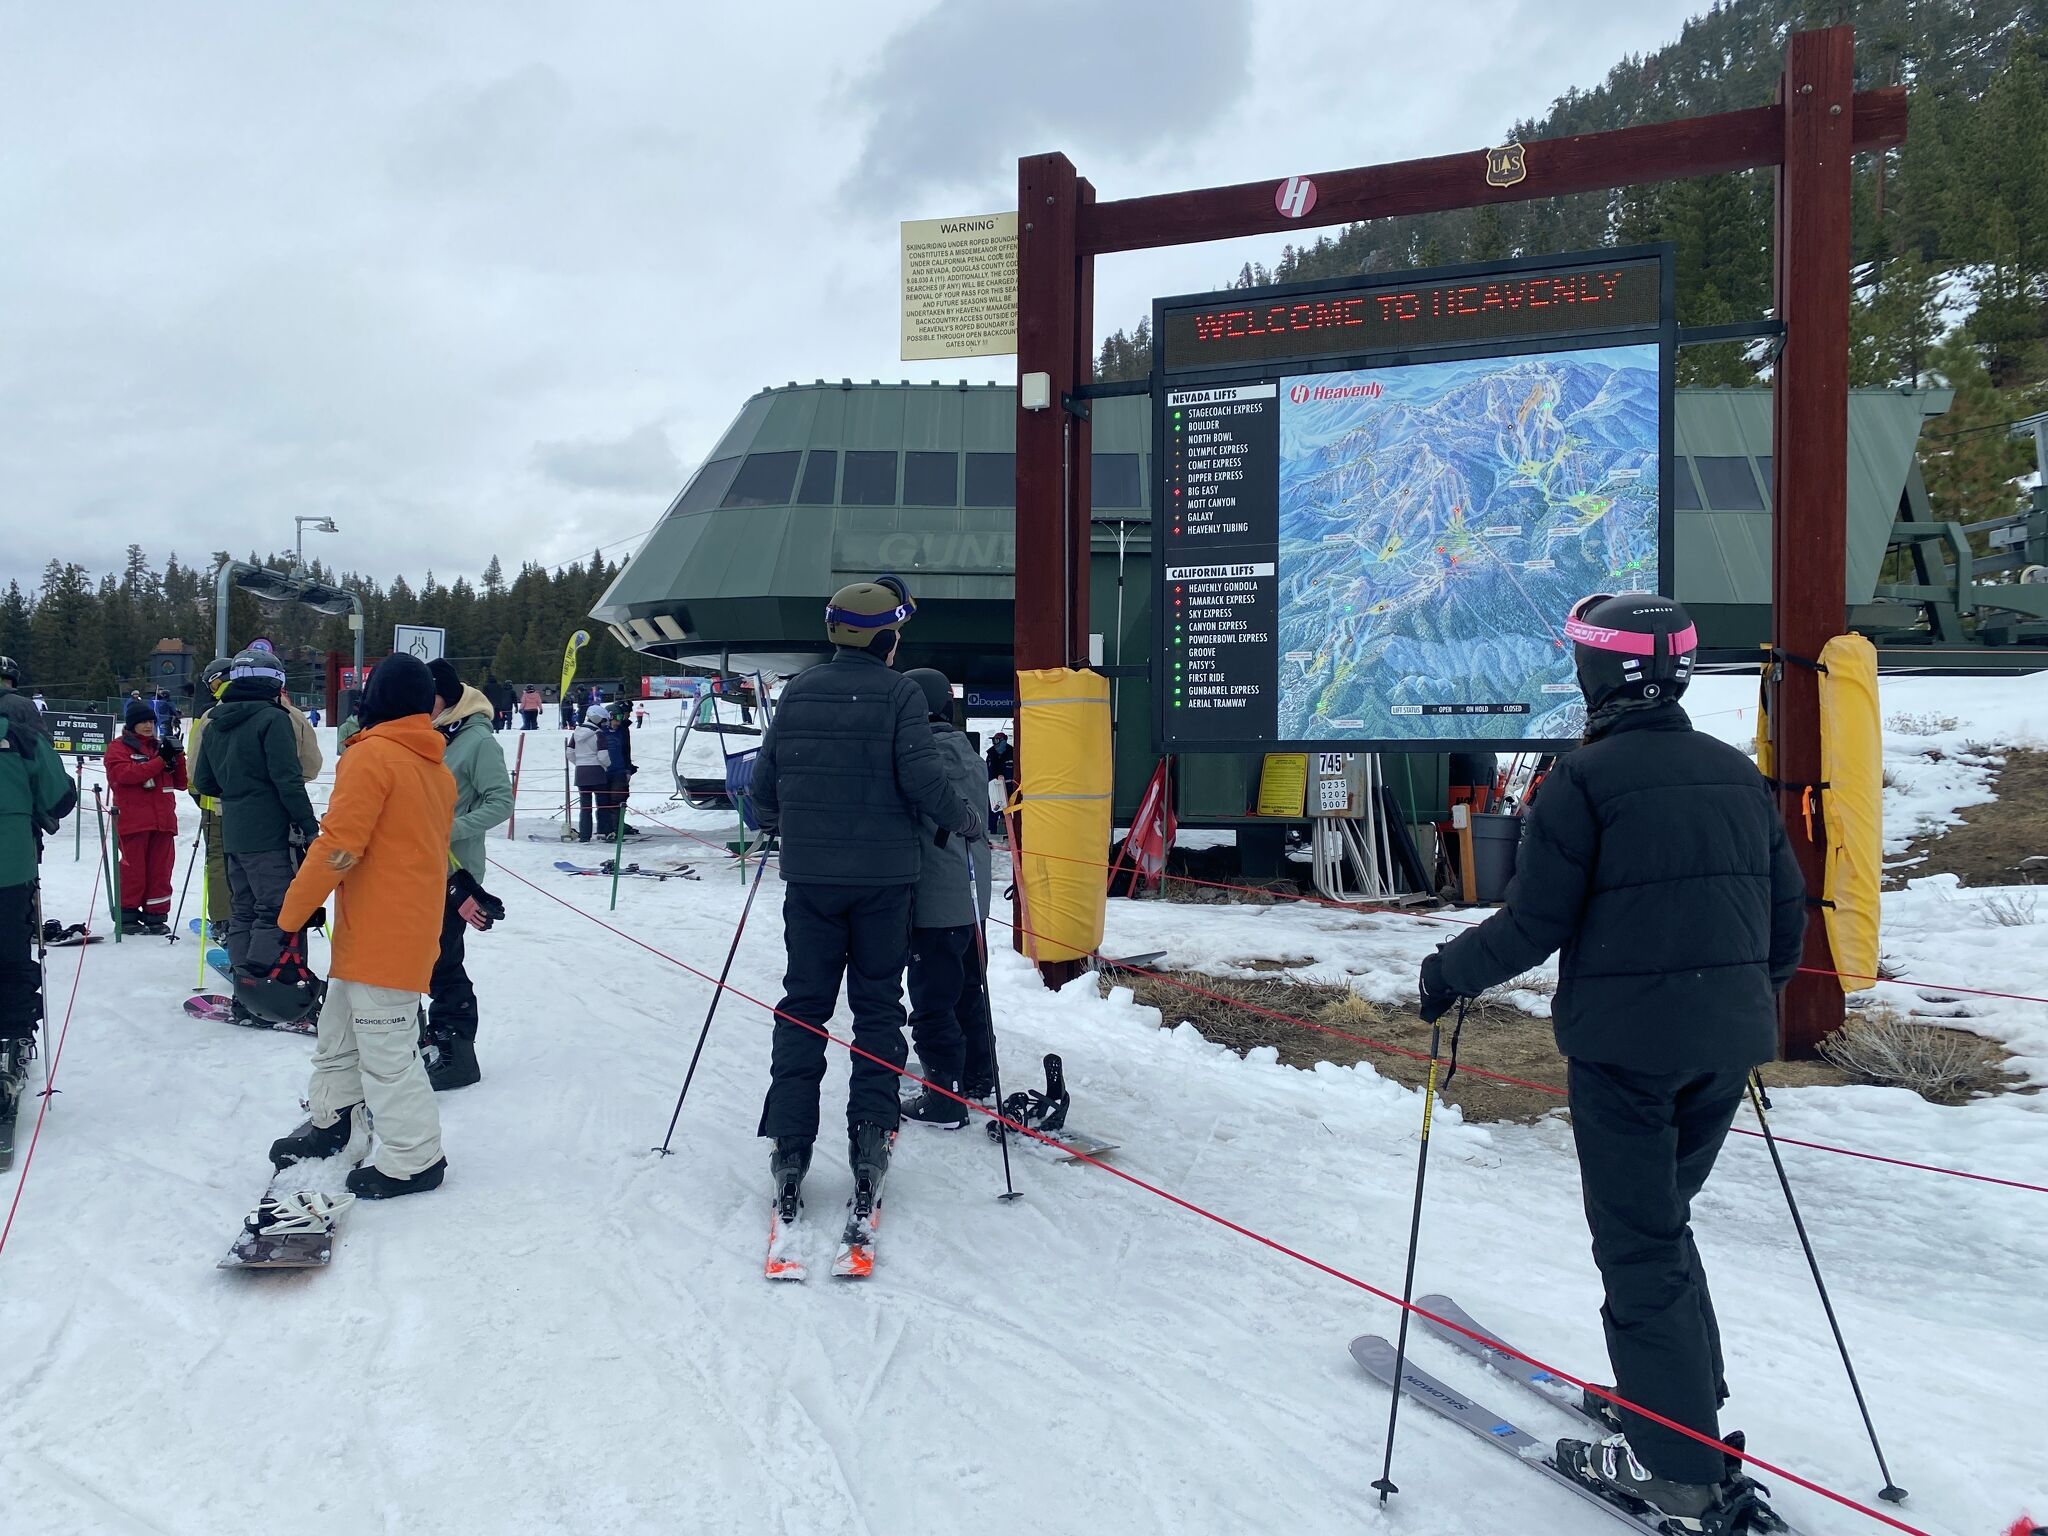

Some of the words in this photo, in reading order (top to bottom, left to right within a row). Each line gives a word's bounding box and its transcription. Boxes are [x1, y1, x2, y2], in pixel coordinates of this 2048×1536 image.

[941, 221, 994, 233] WARNING
[907, 242, 946, 250] SKIING/RIDING
[909, 250, 948, 259] CONSTITUTES
[955, 246, 997, 255] MISDEMEANOR
[932, 257, 966, 265] CALIFORNIA
[952, 264, 979, 272] DOUGLAS
[907, 284, 937, 292] SEARCHES
[986, 278, 1014, 286] CHARGED
[907, 309, 945, 317] UNDERTAKEN
[916, 316, 959, 325] BACKCOUNTRY
[960, 314, 982, 322] ACCESS
[1314, 381, 1384, 400] Heavenly
[1173, 393, 1210, 404] NEVADA
[1214, 390, 1236, 400] LIFTS
[1189, 406, 1231, 418] STAGECOACH
[1234, 403, 1263, 414] EXPRESS
[1189, 421, 1219, 431] BOULDER
[1189, 434, 1211, 444] NORTH
[1214, 433, 1233, 442] BOWL
[1189, 447, 1217, 457] OLYMPIC
[1220, 444, 1248, 454] EXPRESS
[1188, 460, 1210, 470] COMET
[1213, 458, 1241, 468] EXPRESS
[1188, 473, 1212, 483] DIPPER
[1215, 471, 1243, 481] EXPRESS
[1188, 486, 1199, 495] BIG
[1202, 485, 1218, 495] EASY
[1188, 499, 1205, 509] MOTT
[1208, 497, 1235, 508] CANYON
[1188, 512, 1213, 522] GALAXY
[1188, 524, 1220, 534] HEAVENLY
[1223, 523, 1248, 532] TUBING
[1172, 567, 1227, 578] CALIFORNIA
[1231, 566, 1254, 576] LIFTS
[1189, 583, 1221, 593] HEAVENLY
[1224, 582, 1257, 591] GONDOLA
[1189, 596, 1224, 605] TAMARACK
[1227, 595, 1255, 604] EXPRESS
[1189, 609, 1201, 618] SKY
[1204, 608, 1232, 617] EXPRESS
[1189, 622, 1216, 631] CANYON
[1219, 621, 1247, 630] EXPRESS
[1564, 622, 1619, 642] SCOTT
[1189, 634, 1236, 644] POWDERBOWL
[1239, 633, 1267, 643] EXPRESS
[1189, 648, 1216, 657] GROOVE
[1189, 661, 1215, 669] PATSY'S
[1189, 674, 1207, 682] FIRST
[1209, 673, 1224, 682] RIDE
[1189, 686, 1228, 695] GUNBARREL
[1231, 685, 1259, 694] EXPRESS
[1189, 699, 1211, 708] AERIAL
[1214, 699, 1246, 707] TRAMWAY
[1403, 1375, 1469, 1411] SALOMON
